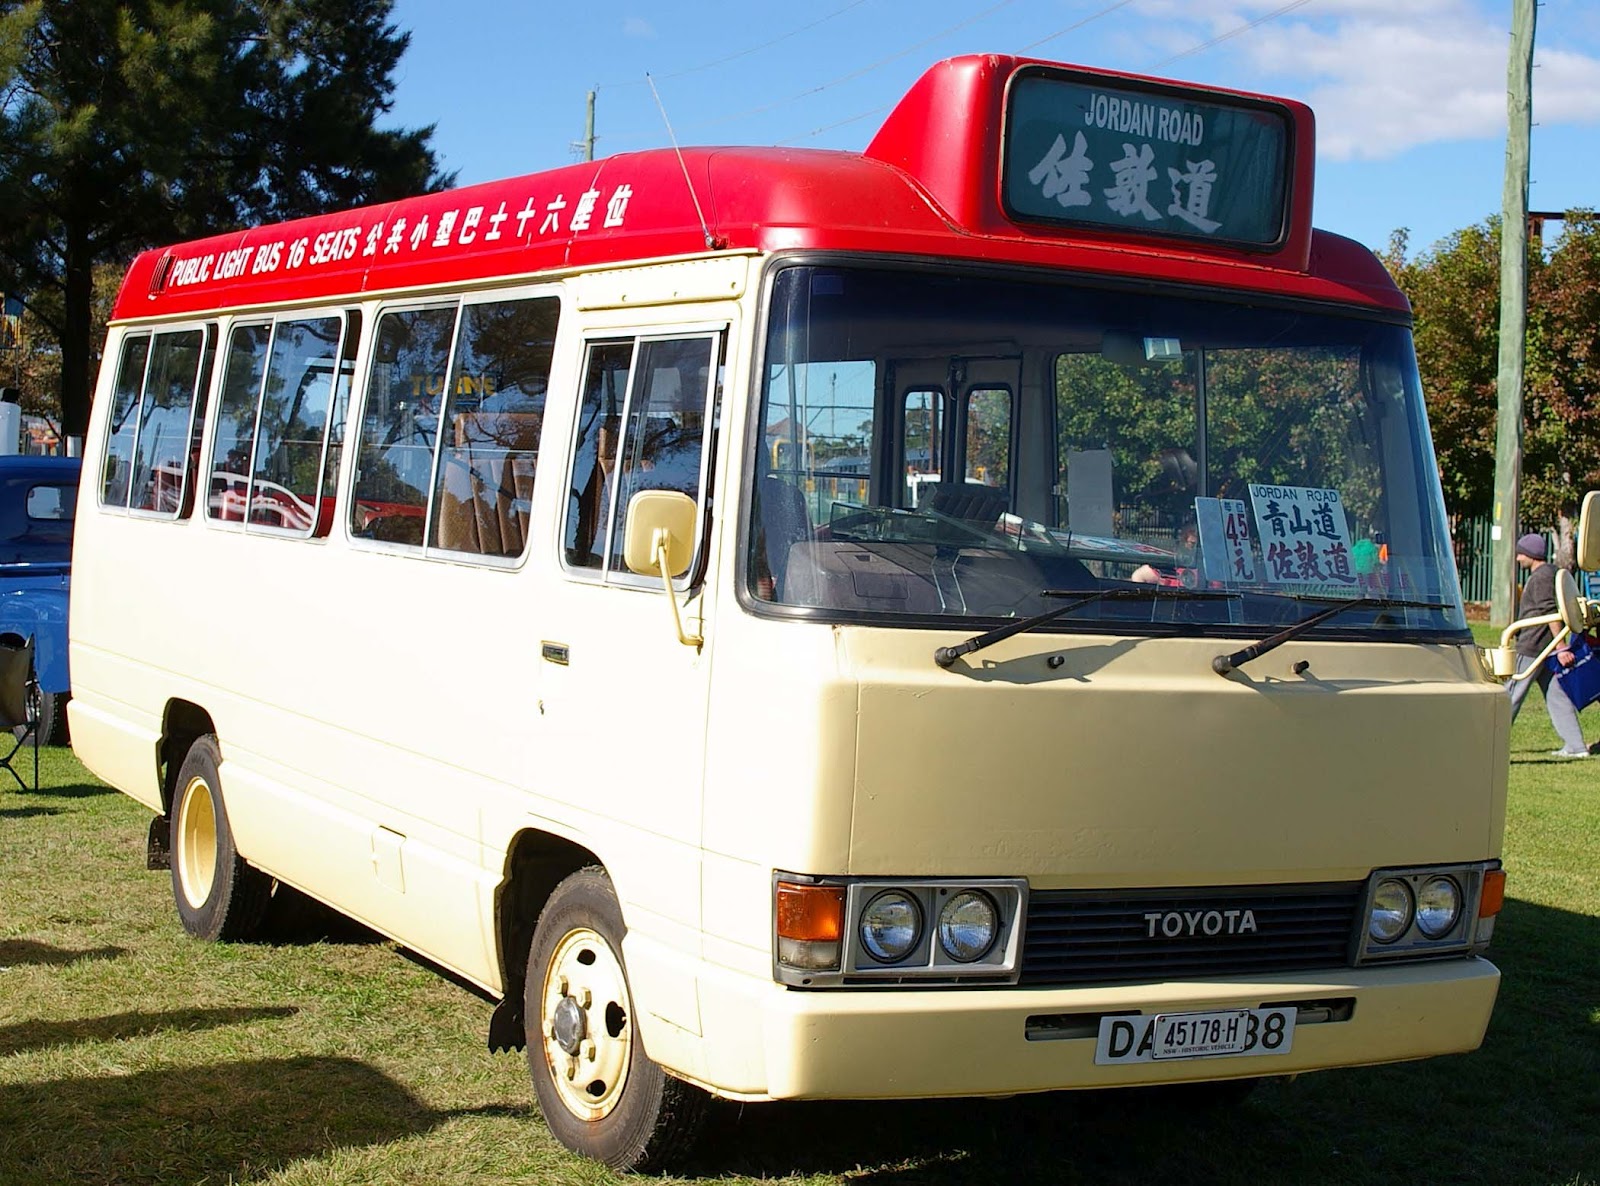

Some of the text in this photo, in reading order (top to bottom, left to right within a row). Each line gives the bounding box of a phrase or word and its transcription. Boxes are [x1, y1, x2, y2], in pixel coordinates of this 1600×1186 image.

[1084, 93, 1204, 146] JORDAN ROAD
[1028, 130, 1223, 234] 佐敦道
[169, 184, 634, 288] PUBLIC LIGHT BUS 16 SEATS 公共小型巴士十六座位
[1253, 485, 1338, 503] JORDAN ROAD
[1262, 500, 1341, 540] 青山道
[1267, 541, 1357, 583] 佐敦道
[1144, 909, 1258, 938] TOYOTA
[1164, 1017, 1239, 1047] 45178-H
[1181, 1045, 1209, 1054] HISTORIC
[1210, 1043, 1235, 1052] VEHICLE
